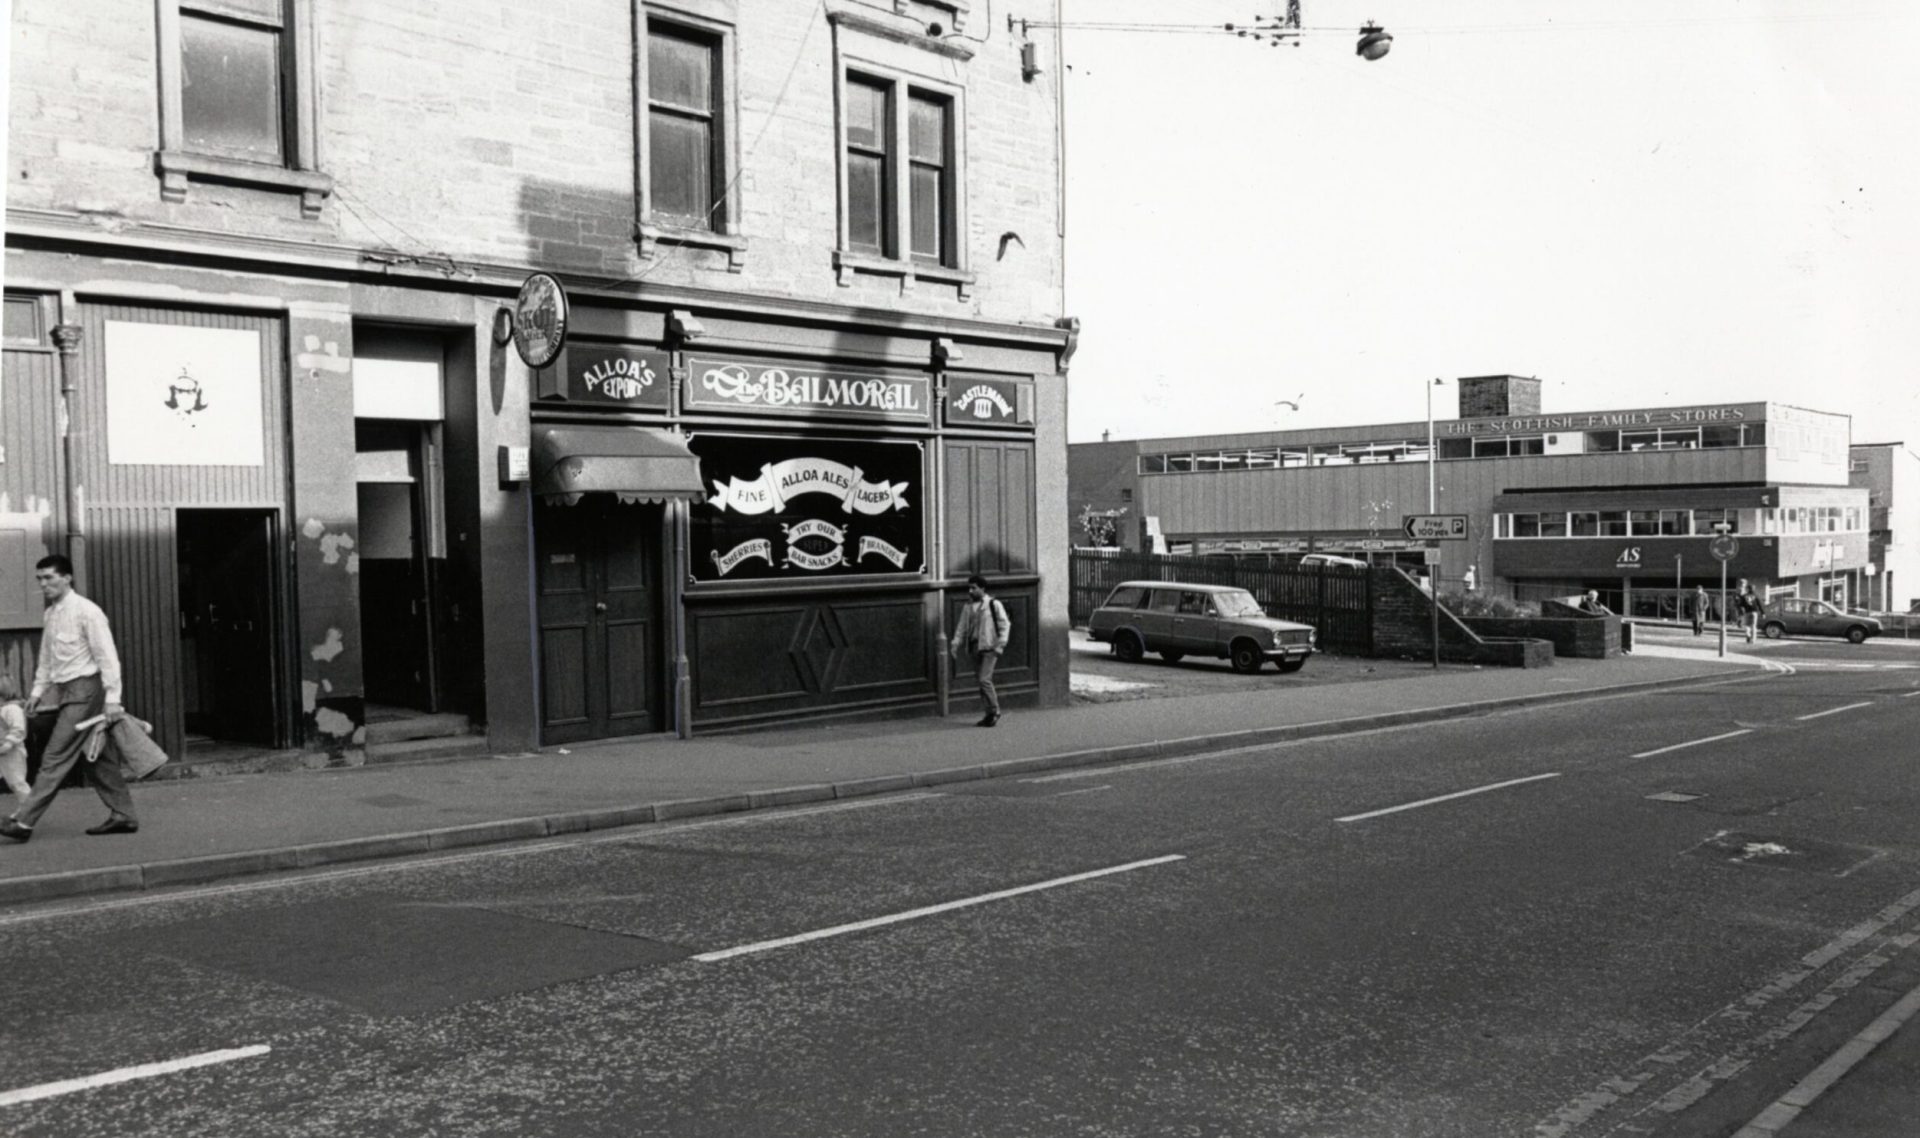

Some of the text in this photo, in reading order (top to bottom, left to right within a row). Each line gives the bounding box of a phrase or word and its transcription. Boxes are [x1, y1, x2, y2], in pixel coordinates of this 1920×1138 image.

[583, 358, 656, 392] ALLOA'S
[603, 377, 643, 399] EXPORT
[702, 364, 919, 411] The BALMORAL
[1447, 408, 1744, 434] THE SCOTTISH FAMILY STORES
[737, 469, 890, 504] FINE ALLOA ALES LAGERS
[797, 523, 837, 537] TRY OUR
[722, 542, 764, 569] SHERRIES
[791, 550, 839, 567] BAR SNACKS
